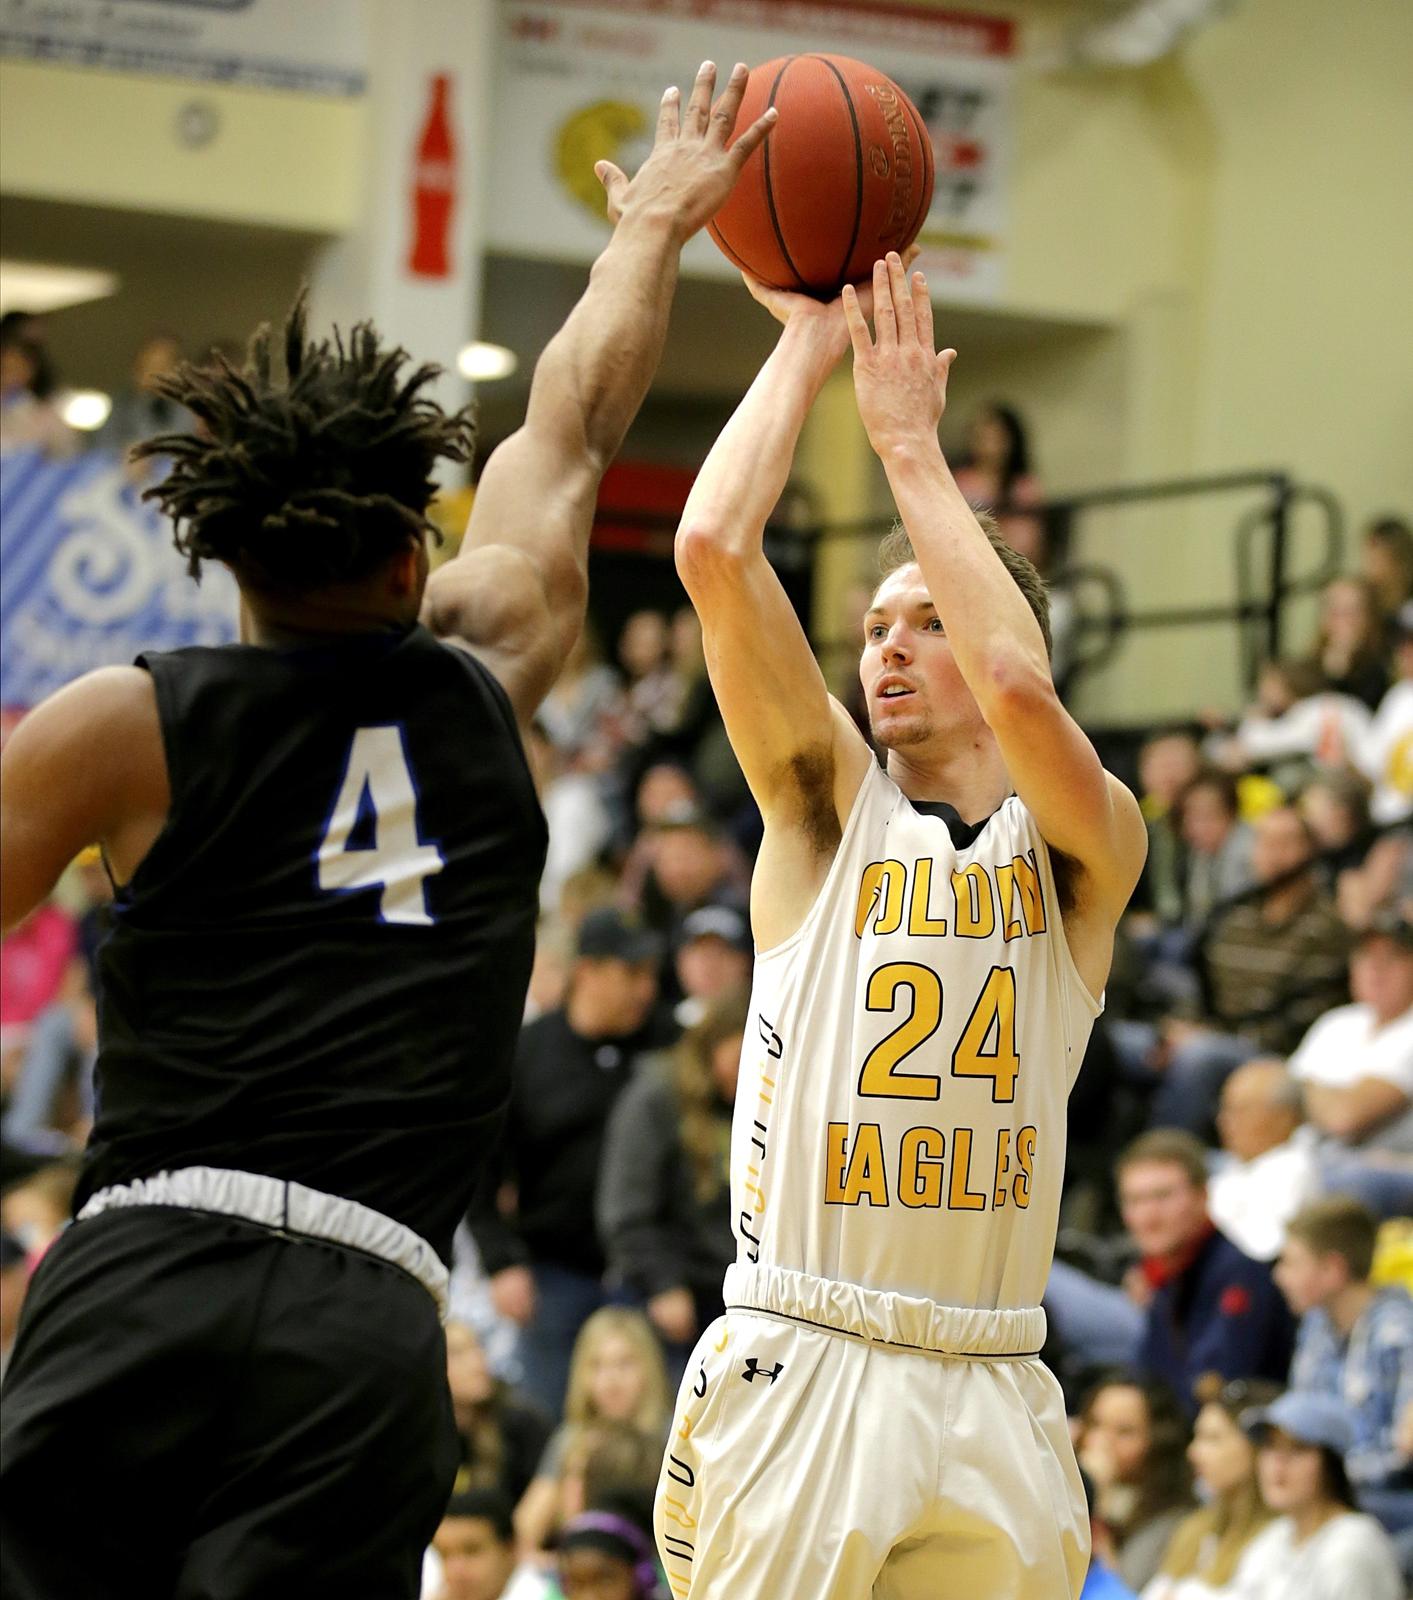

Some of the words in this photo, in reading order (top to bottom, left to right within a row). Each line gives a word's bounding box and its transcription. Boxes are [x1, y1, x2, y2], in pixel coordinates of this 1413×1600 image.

[313, 723, 446, 927] 4
[857, 960, 1020, 1103] 24
[824, 1121, 1037, 1211] EAGLES
